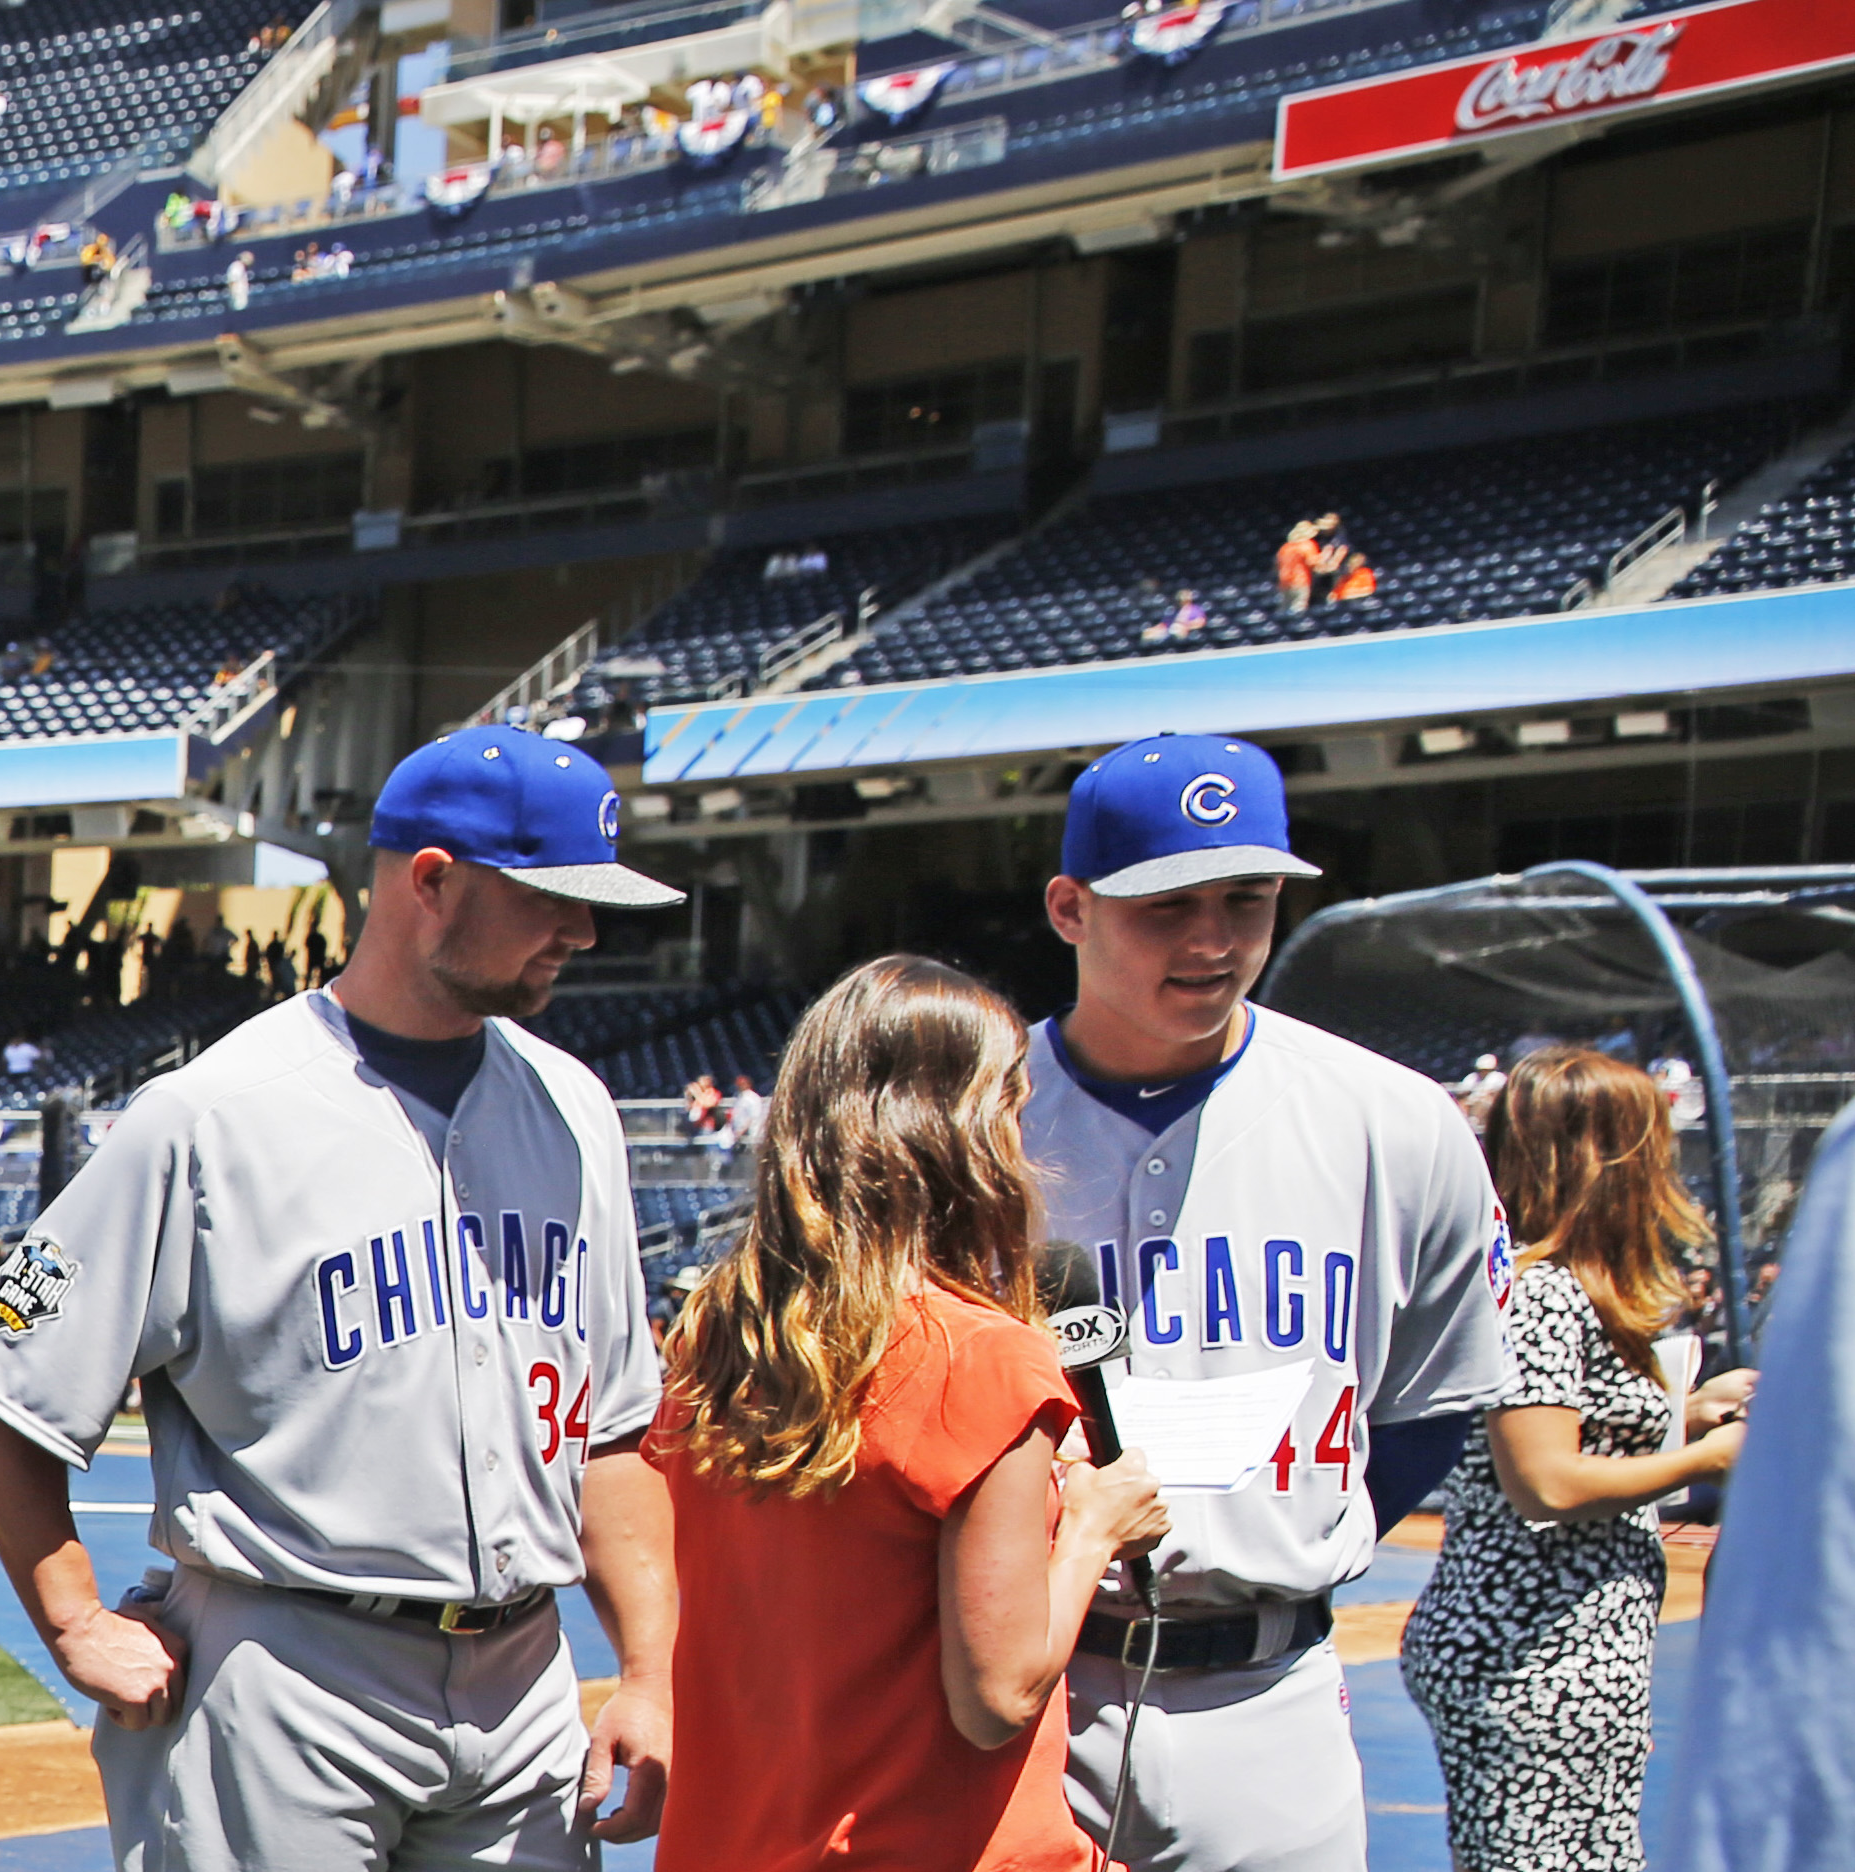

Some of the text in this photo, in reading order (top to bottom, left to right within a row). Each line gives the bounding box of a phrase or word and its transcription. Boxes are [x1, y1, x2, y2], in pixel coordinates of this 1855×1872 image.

[1180, 773, 1238, 828] C
[318, 1211, 588, 1366] CHICAGO
[1099, 1235, 1354, 1363] ICAGO
[1060, 1337, 1109, 1356] PORTS
[528, 1361, 591, 1466] 34
